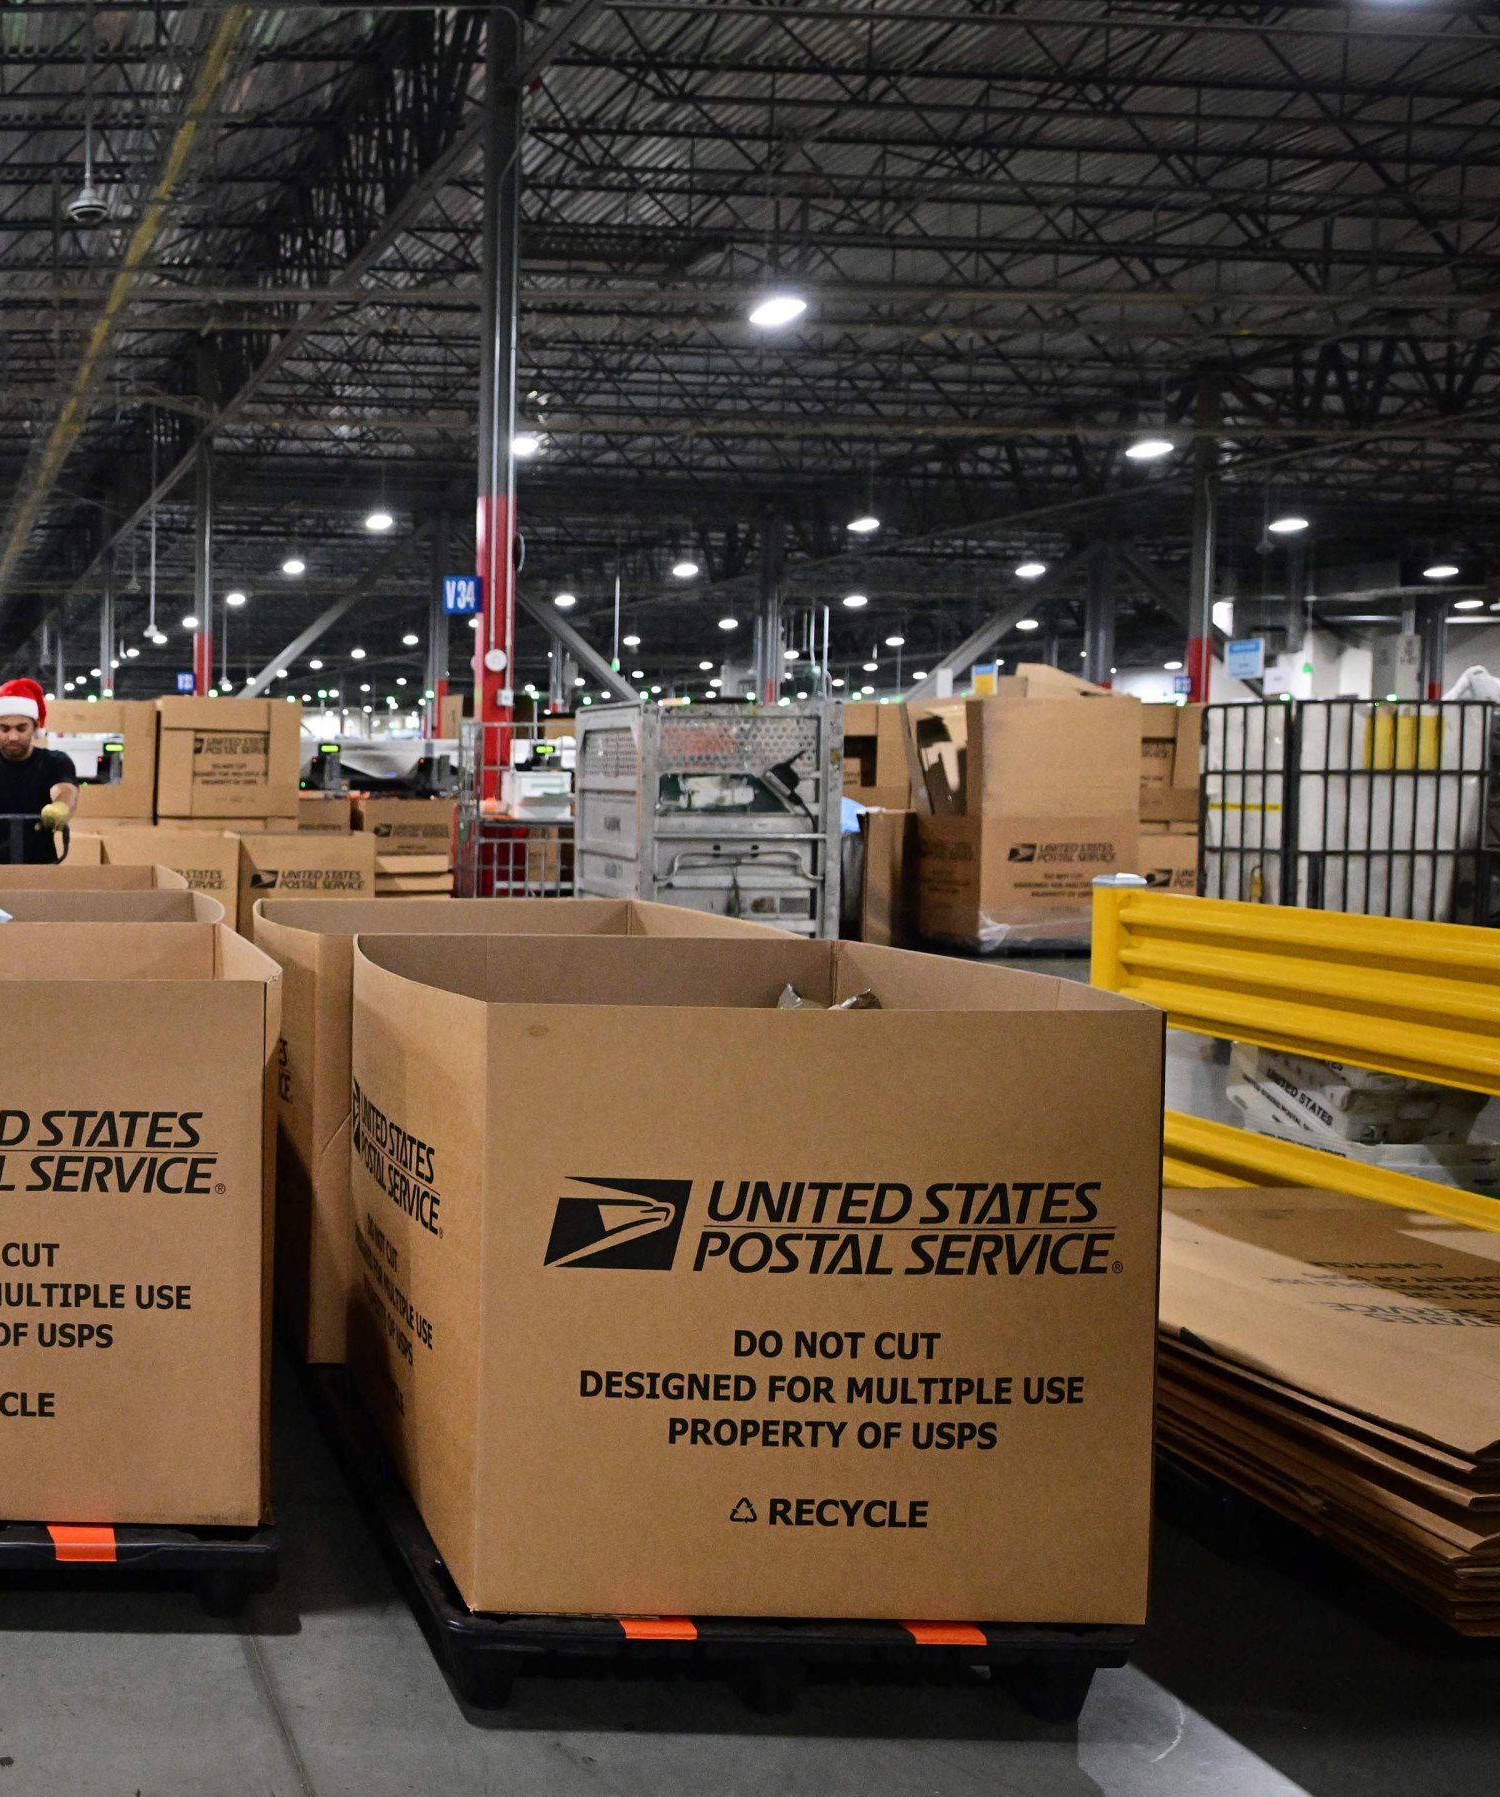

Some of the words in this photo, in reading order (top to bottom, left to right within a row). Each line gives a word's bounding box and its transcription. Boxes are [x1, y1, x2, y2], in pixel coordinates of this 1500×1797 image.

[445, 580, 476, 609] V34
[278, 880, 318, 889] POSTAL
[321, 880, 365, 890] SERVICE
[280, 869, 323, 880] UNITED
[324, 869, 362, 880] STATES
[1299, 1092, 1334, 1127] STATES
[37, 1111, 203, 1148] STATES
[361, 1094, 388, 1149] UNITED
[388, 1121, 435, 1185] STATES
[708, 1181, 912, 1224] UNITED
[919, 1181, 1102, 1224] STATES
[2, 1243, 59, 1267] CUT
[693, 1232, 893, 1275] POSTAL
[136, 1285, 191, 1309] USE
[38, 1323, 113, 1348] USPS
[415, 1311, 433, 1351] USE
[734, 1330, 782, 1358] DO
[795, 1331, 865, 1359] NOT
[875, 1332, 941, 1360] CUT
[580, 1370, 756, 1401] DESIGNED
[769, 1376, 836, 1403] FOR
[847, 1377, 1012, 1404] MULTIPLE
[1024, 1376, 1084, 1404] USE
[669, 1418, 848, 1448] PROPERTY
[857, 1422, 902, 1449] OF
[913, 1422, 997, 1450] USPS
[769, 1499, 929, 1528] RECYCLE
